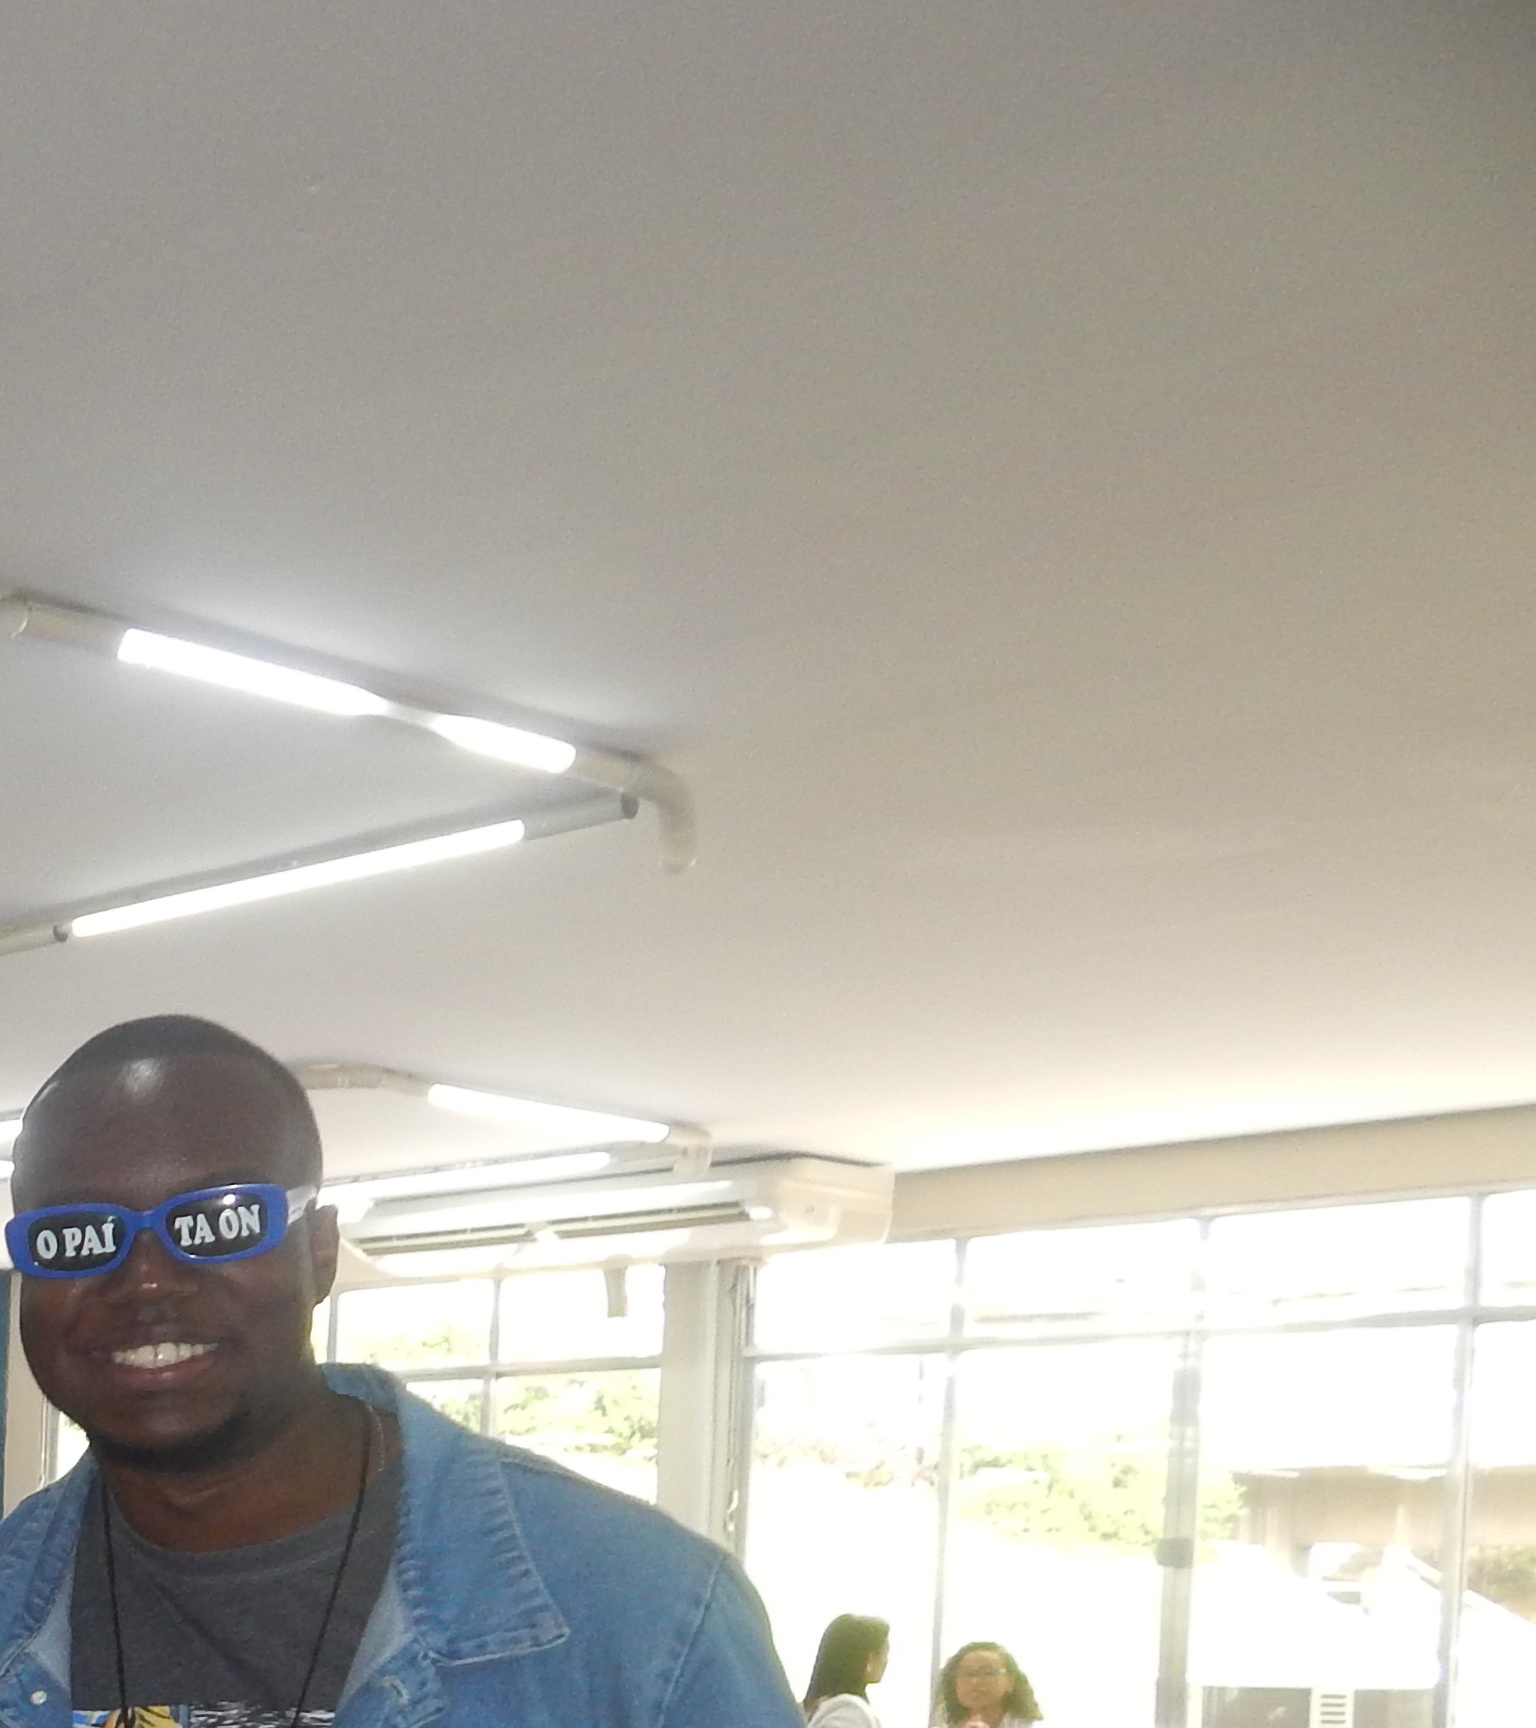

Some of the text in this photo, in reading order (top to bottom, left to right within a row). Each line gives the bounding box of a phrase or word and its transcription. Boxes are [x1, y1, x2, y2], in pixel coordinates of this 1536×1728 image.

[36, 1204, 261, 1259] O PAÍ TA ON
